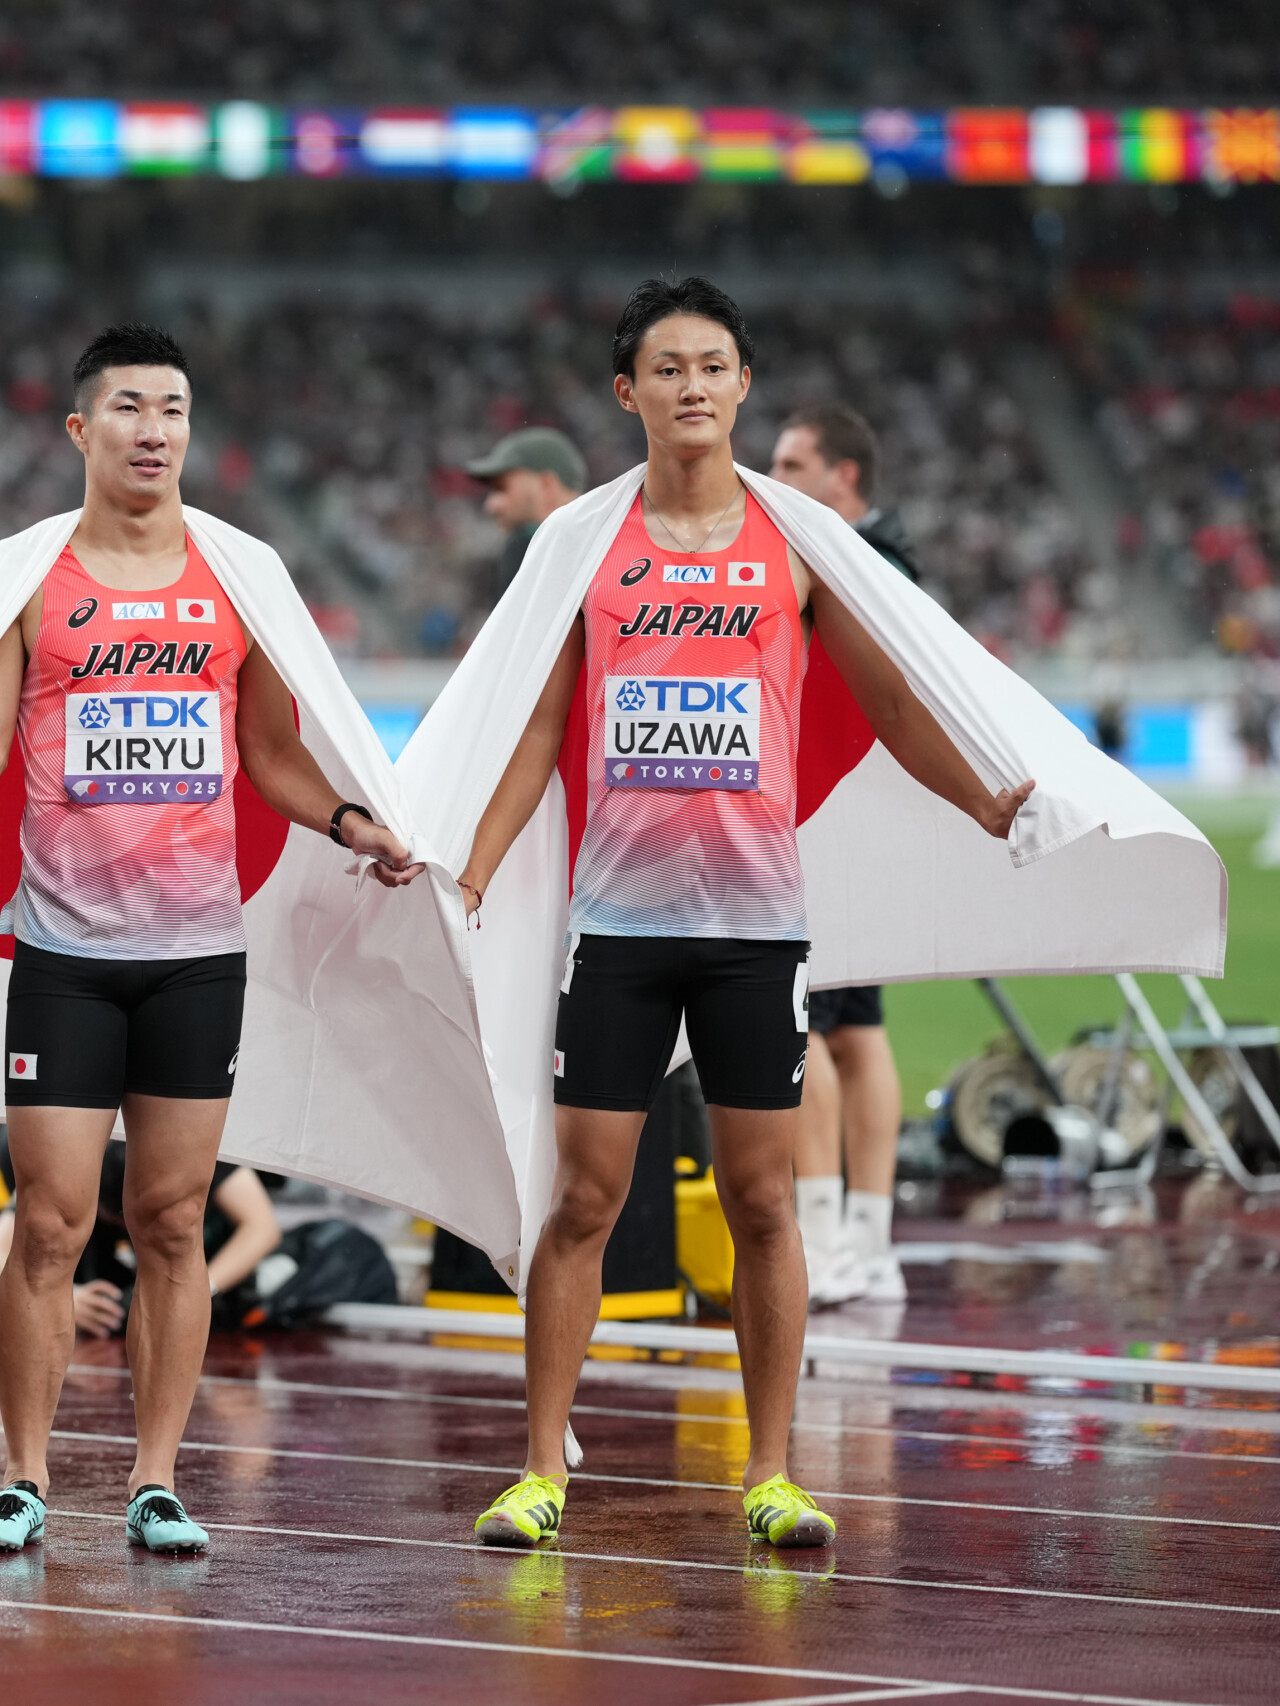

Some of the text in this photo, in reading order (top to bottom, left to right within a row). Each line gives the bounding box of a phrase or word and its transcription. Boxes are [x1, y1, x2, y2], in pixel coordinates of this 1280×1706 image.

[666, 567, 713, 582] ACN
[115, 603, 161, 618] ACN
[619, 604, 761, 638] JAPAN
[71, 641, 213, 679] JAPAN
[109, 697, 209, 728] TDK
[646, 680, 749, 714] TDK
[86, 738, 205, 771] KIRYU
[615, 722, 751, 756] UZAWA
